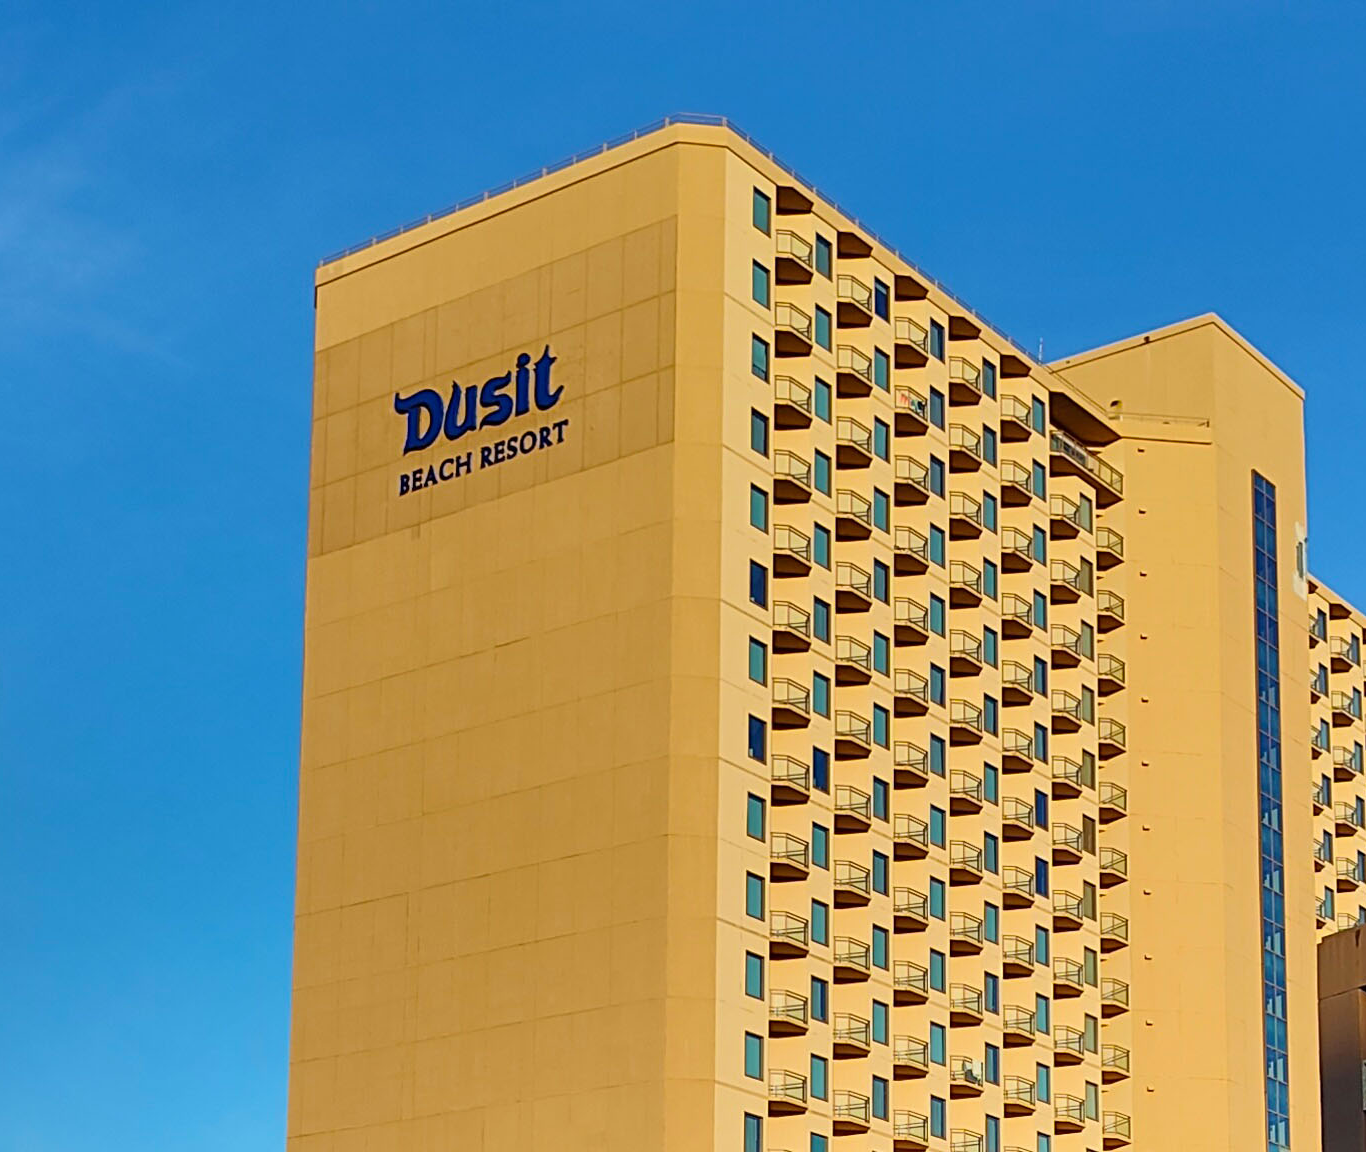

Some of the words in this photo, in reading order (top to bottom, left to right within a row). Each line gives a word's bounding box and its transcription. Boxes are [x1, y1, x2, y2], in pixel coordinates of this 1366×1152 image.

[394, 344, 564, 456] Dusit
[399, 452, 472, 497] BEACH
[480, 419, 569, 469] RESORT
